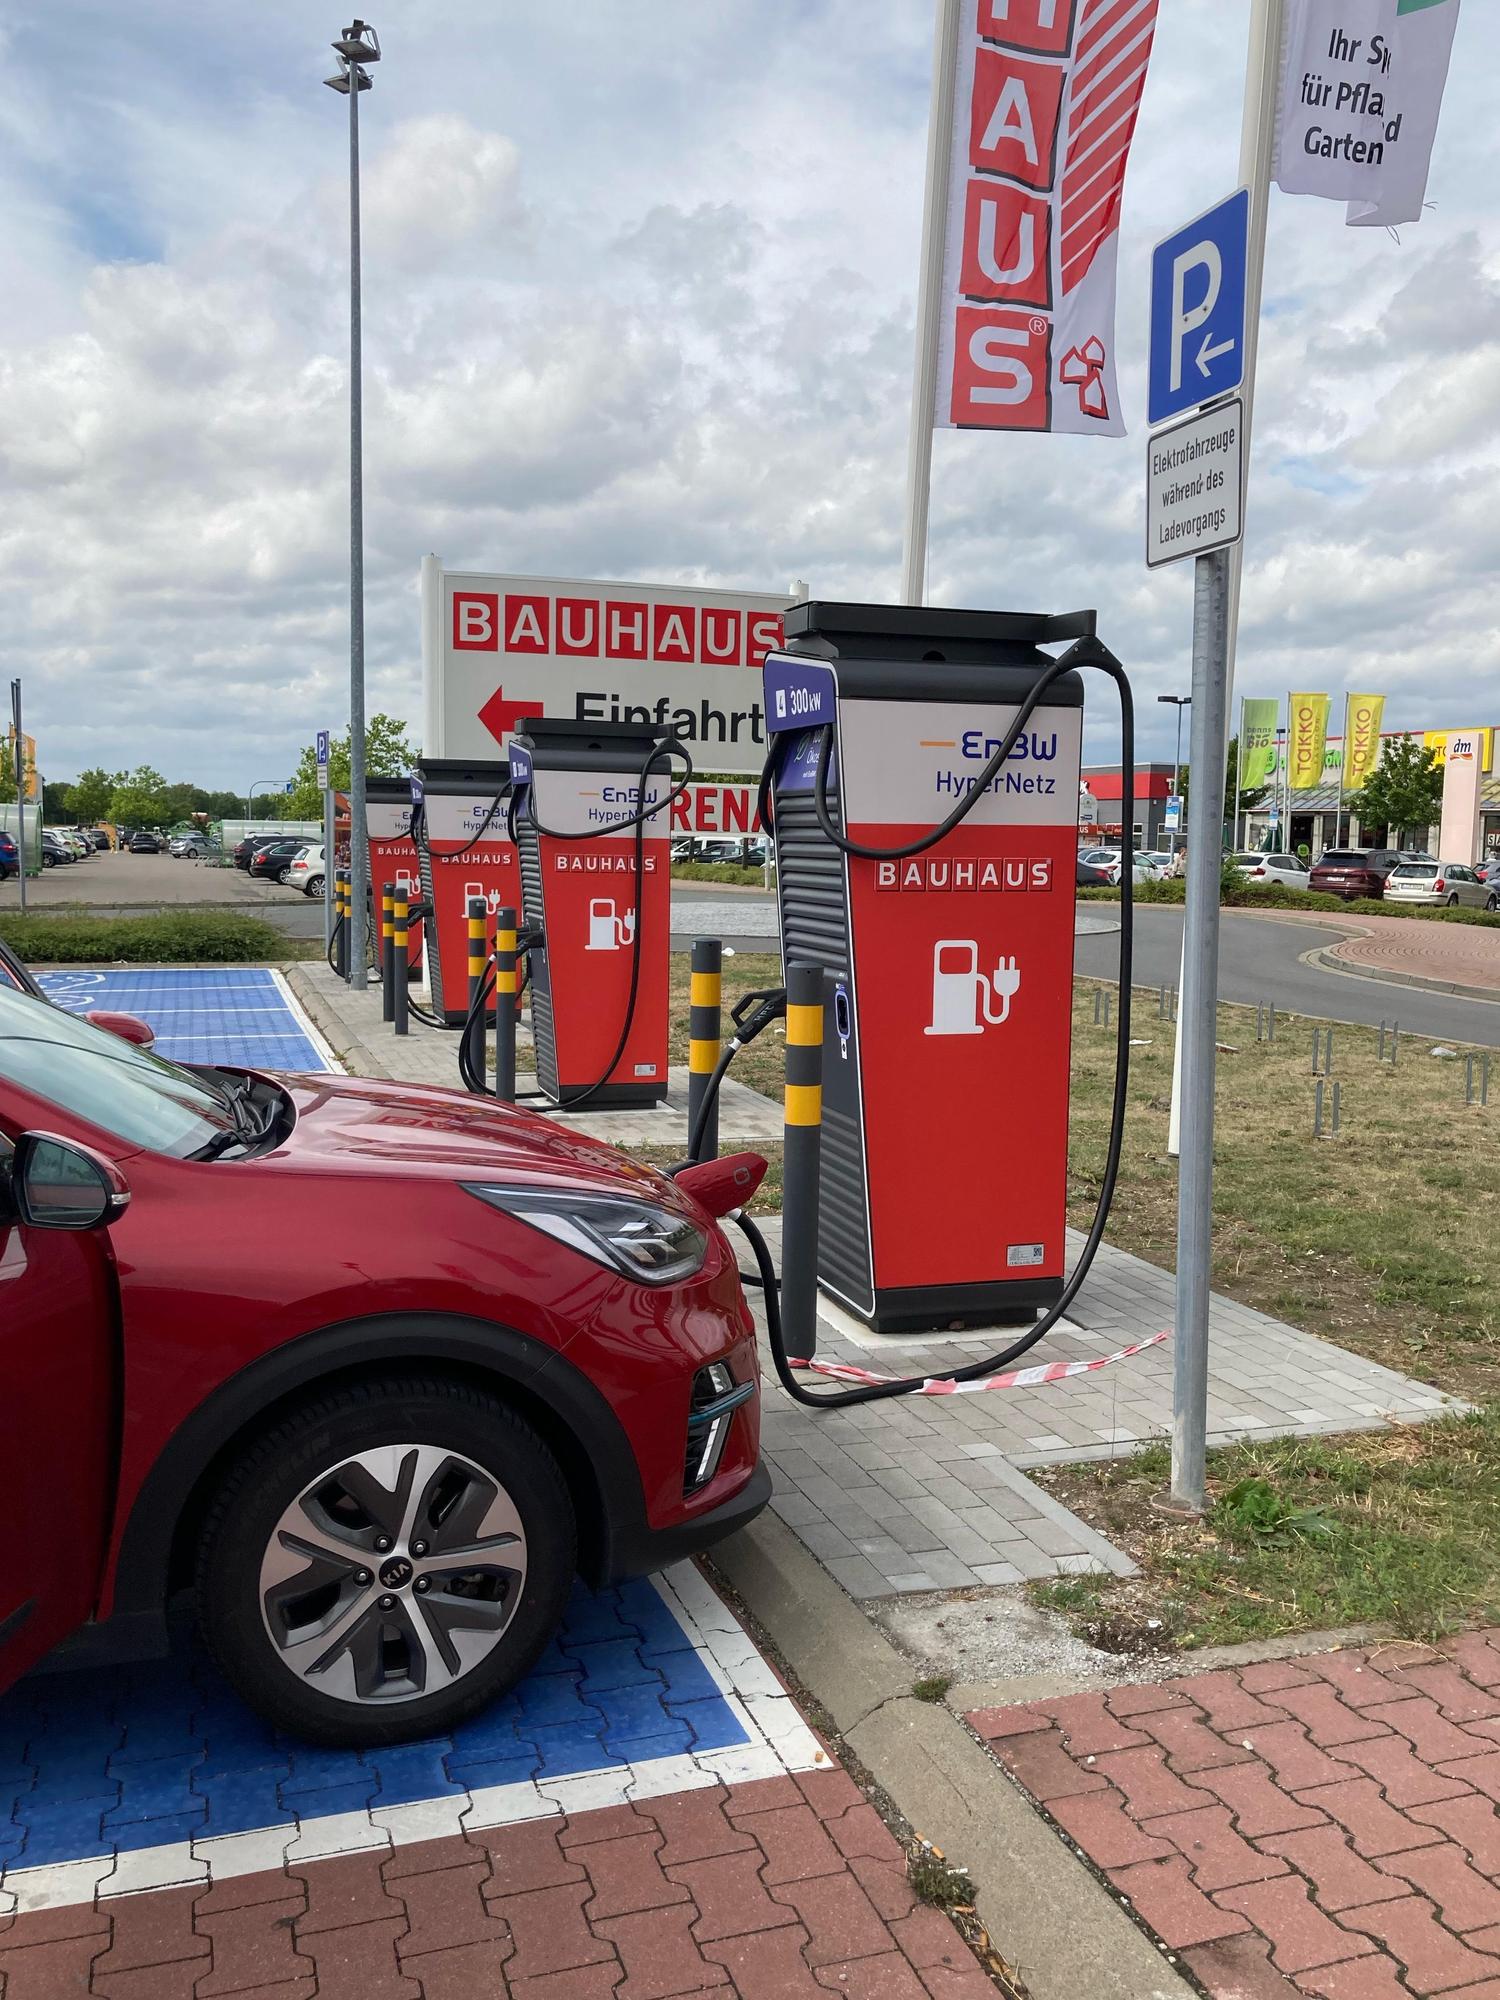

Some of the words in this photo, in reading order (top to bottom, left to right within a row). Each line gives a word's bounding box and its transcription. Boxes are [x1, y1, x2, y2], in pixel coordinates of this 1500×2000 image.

[1328, 28, 1362, 63] Ihr
[1301, 73, 1333, 107] für
[1304, 126, 1384, 165] Garten
[1170, 240, 1222, 393] P
[1153, 428, 1235, 476] Elektrofahrzeuge
[1162, 473, 1202, 508] während
[1206, 469, 1224, 491] des
[1160, 508, 1226, 544] Ladevorgangs
[459, 601, 779, 659] BAUHAUS
[1454, 738, 1471, 753] dm
[589, 808, 657, 823] HyperNz
[378, 847, 416, 855] BAUHA
[879, 862, 1049, 886] BAUHAUS
[383, 1563, 410, 1586] KIA
